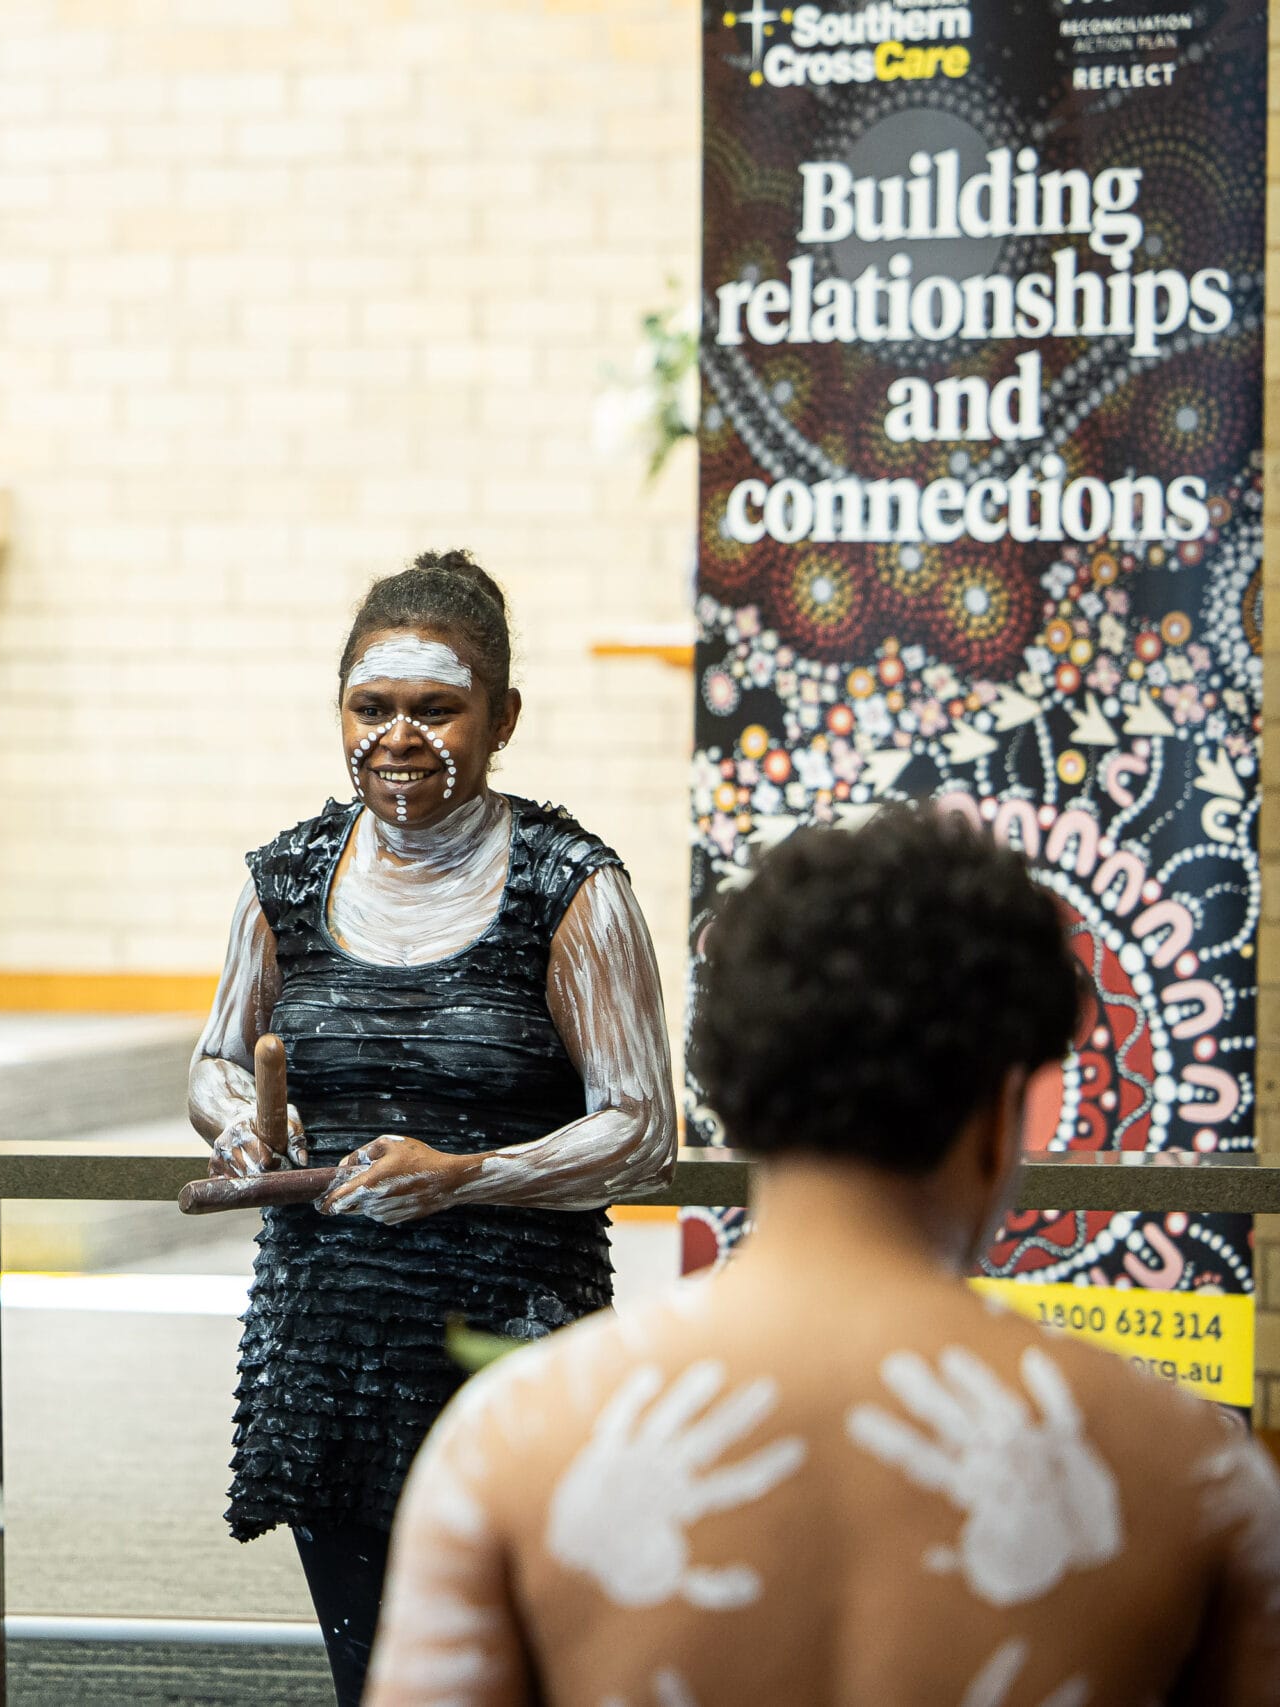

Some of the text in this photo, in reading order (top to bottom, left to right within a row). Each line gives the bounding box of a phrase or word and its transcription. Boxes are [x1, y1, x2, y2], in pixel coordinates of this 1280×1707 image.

[791, 3, 972, 47] Southern
[1059, 13, 1193, 36] RECONCILIATION
[1073, 32, 1177, 53] ACTION PLAN
[764, 41, 971, 87] CrossCare
[1073, 62, 1176, 90] REFLECT
[798, 147, 1143, 256] Building
[716, 246, 1233, 357] relationships
[884, 350, 1043, 441] and
[725, 453, 1210, 544] connections
[1038, 1302, 1222, 1339] 1800 632 314
[1128, 1355, 1222, 1384] org.au
